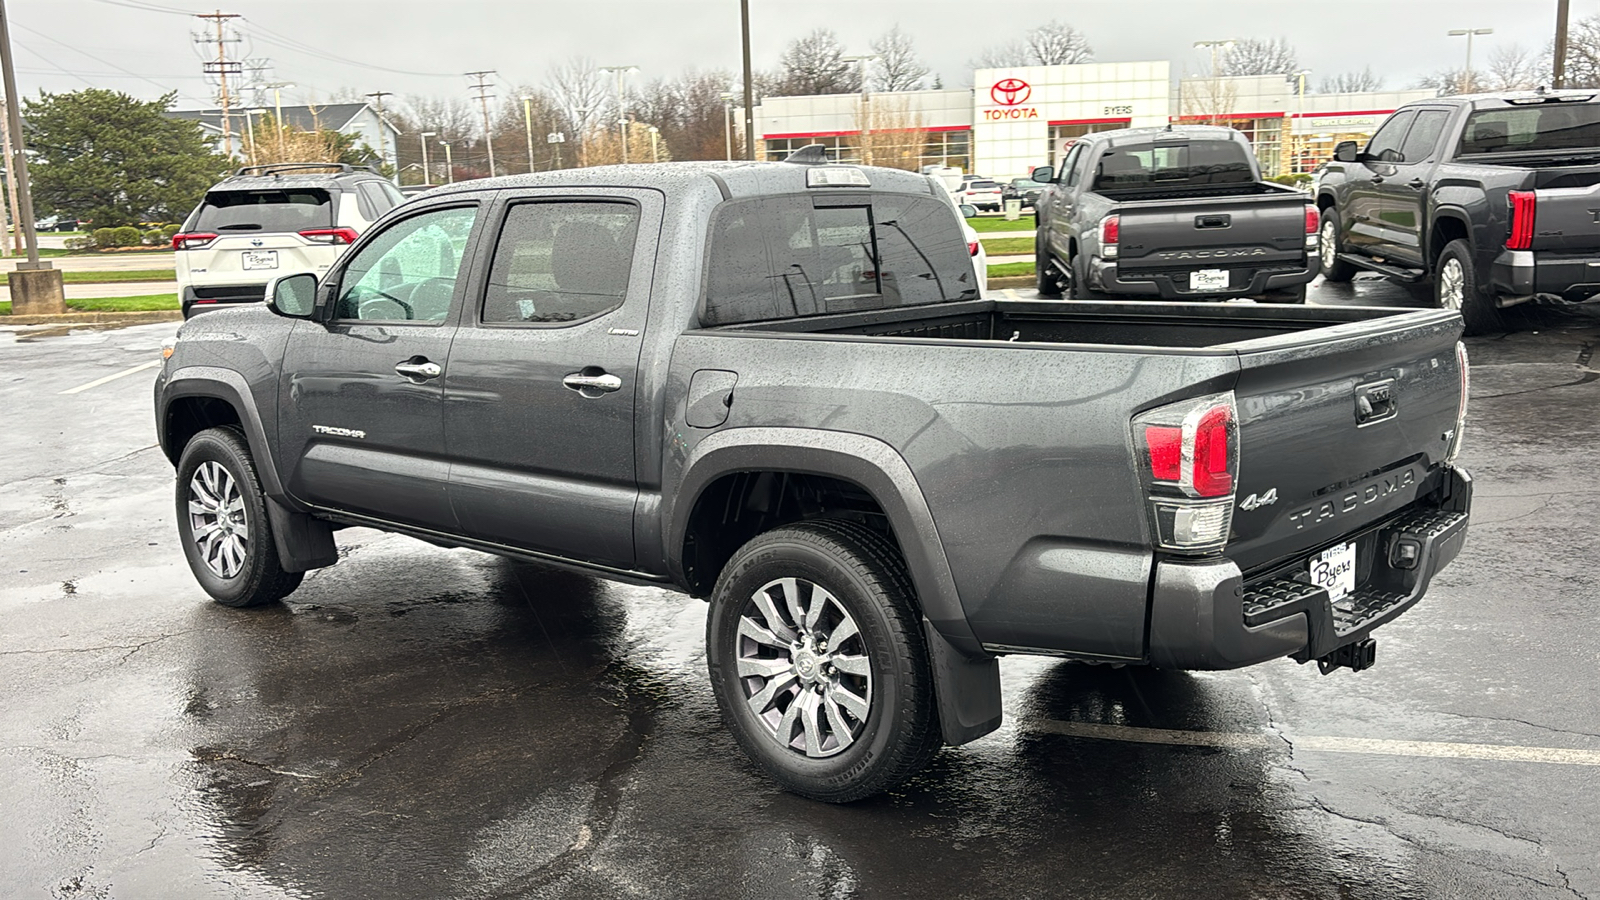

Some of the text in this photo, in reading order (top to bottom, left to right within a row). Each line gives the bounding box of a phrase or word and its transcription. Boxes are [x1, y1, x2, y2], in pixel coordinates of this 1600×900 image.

[983, 107, 1038, 120] TOYOTA
[1103, 105, 1133, 115] BYERS
[1159, 248, 1267, 260] TACOMA
[312, 424, 366, 439] TACOMA
[1289, 468, 1415, 530] TACOMA
[1313, 560, 1351, 588] Byers
